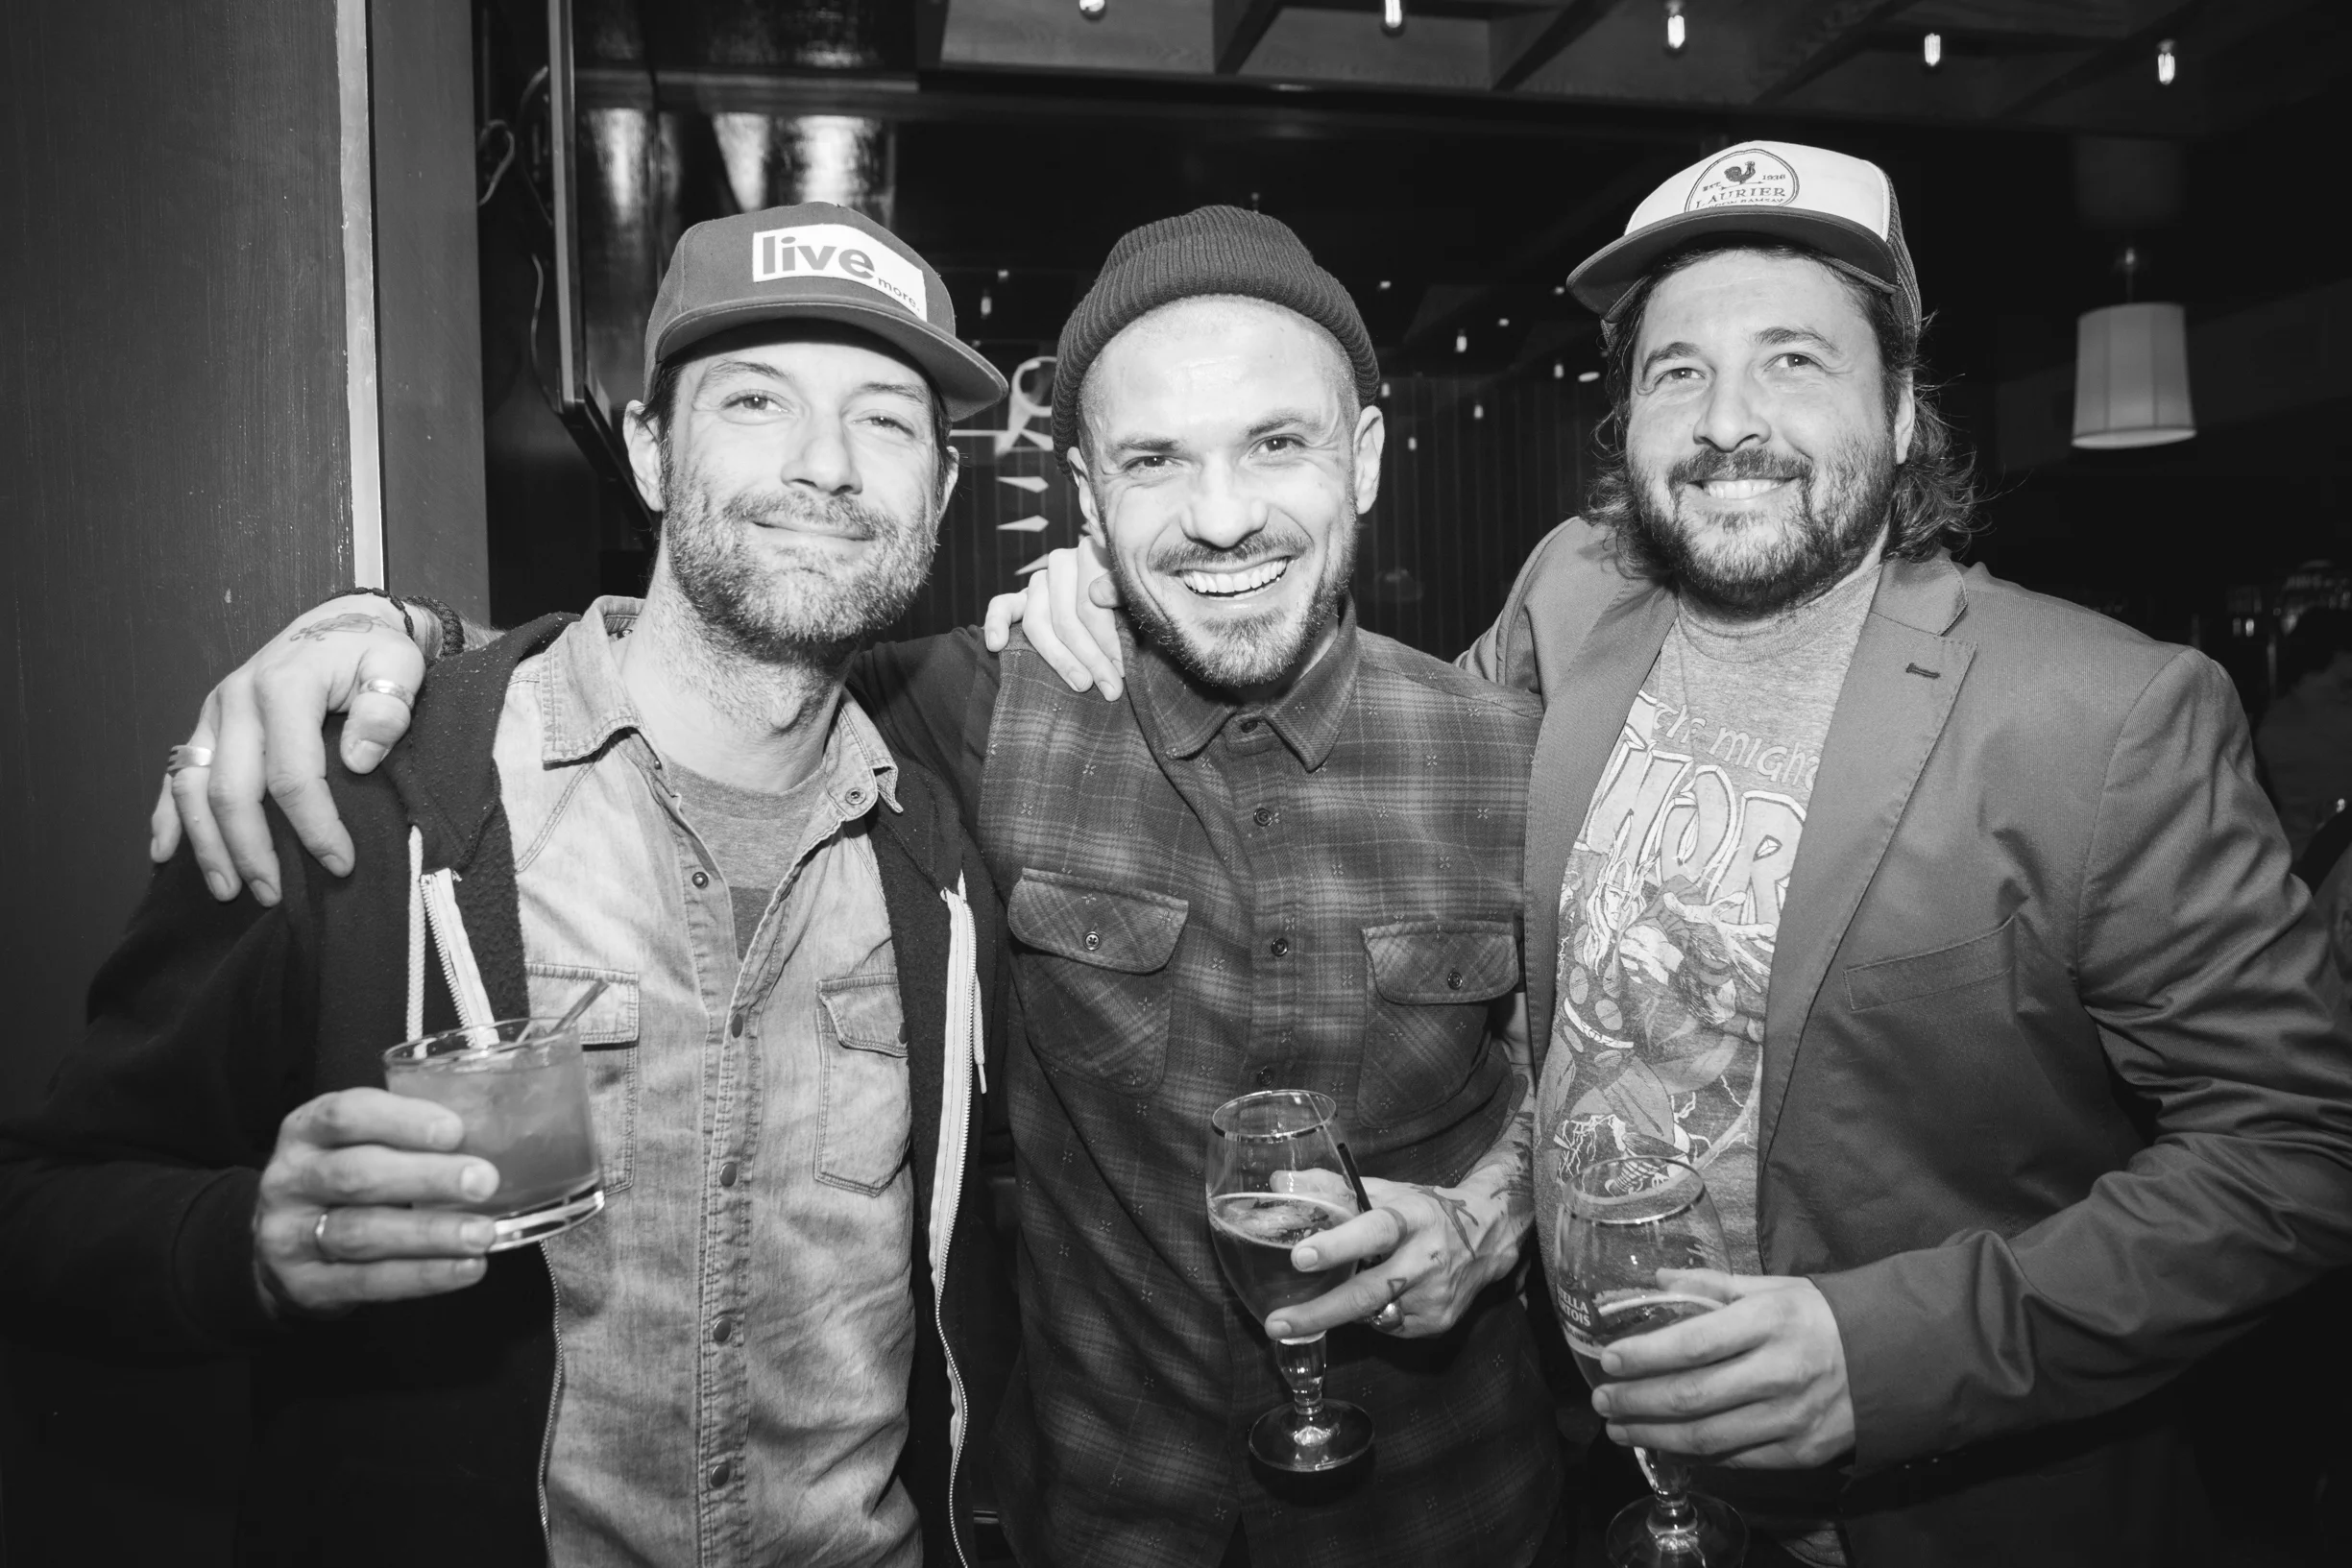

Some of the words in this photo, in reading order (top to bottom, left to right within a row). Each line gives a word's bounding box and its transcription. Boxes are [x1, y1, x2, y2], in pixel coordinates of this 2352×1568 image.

[1696, 187, 1785, 208] LAURIER
[763, 235, 876, 279] live
[878, 277, 921, 312] more.
